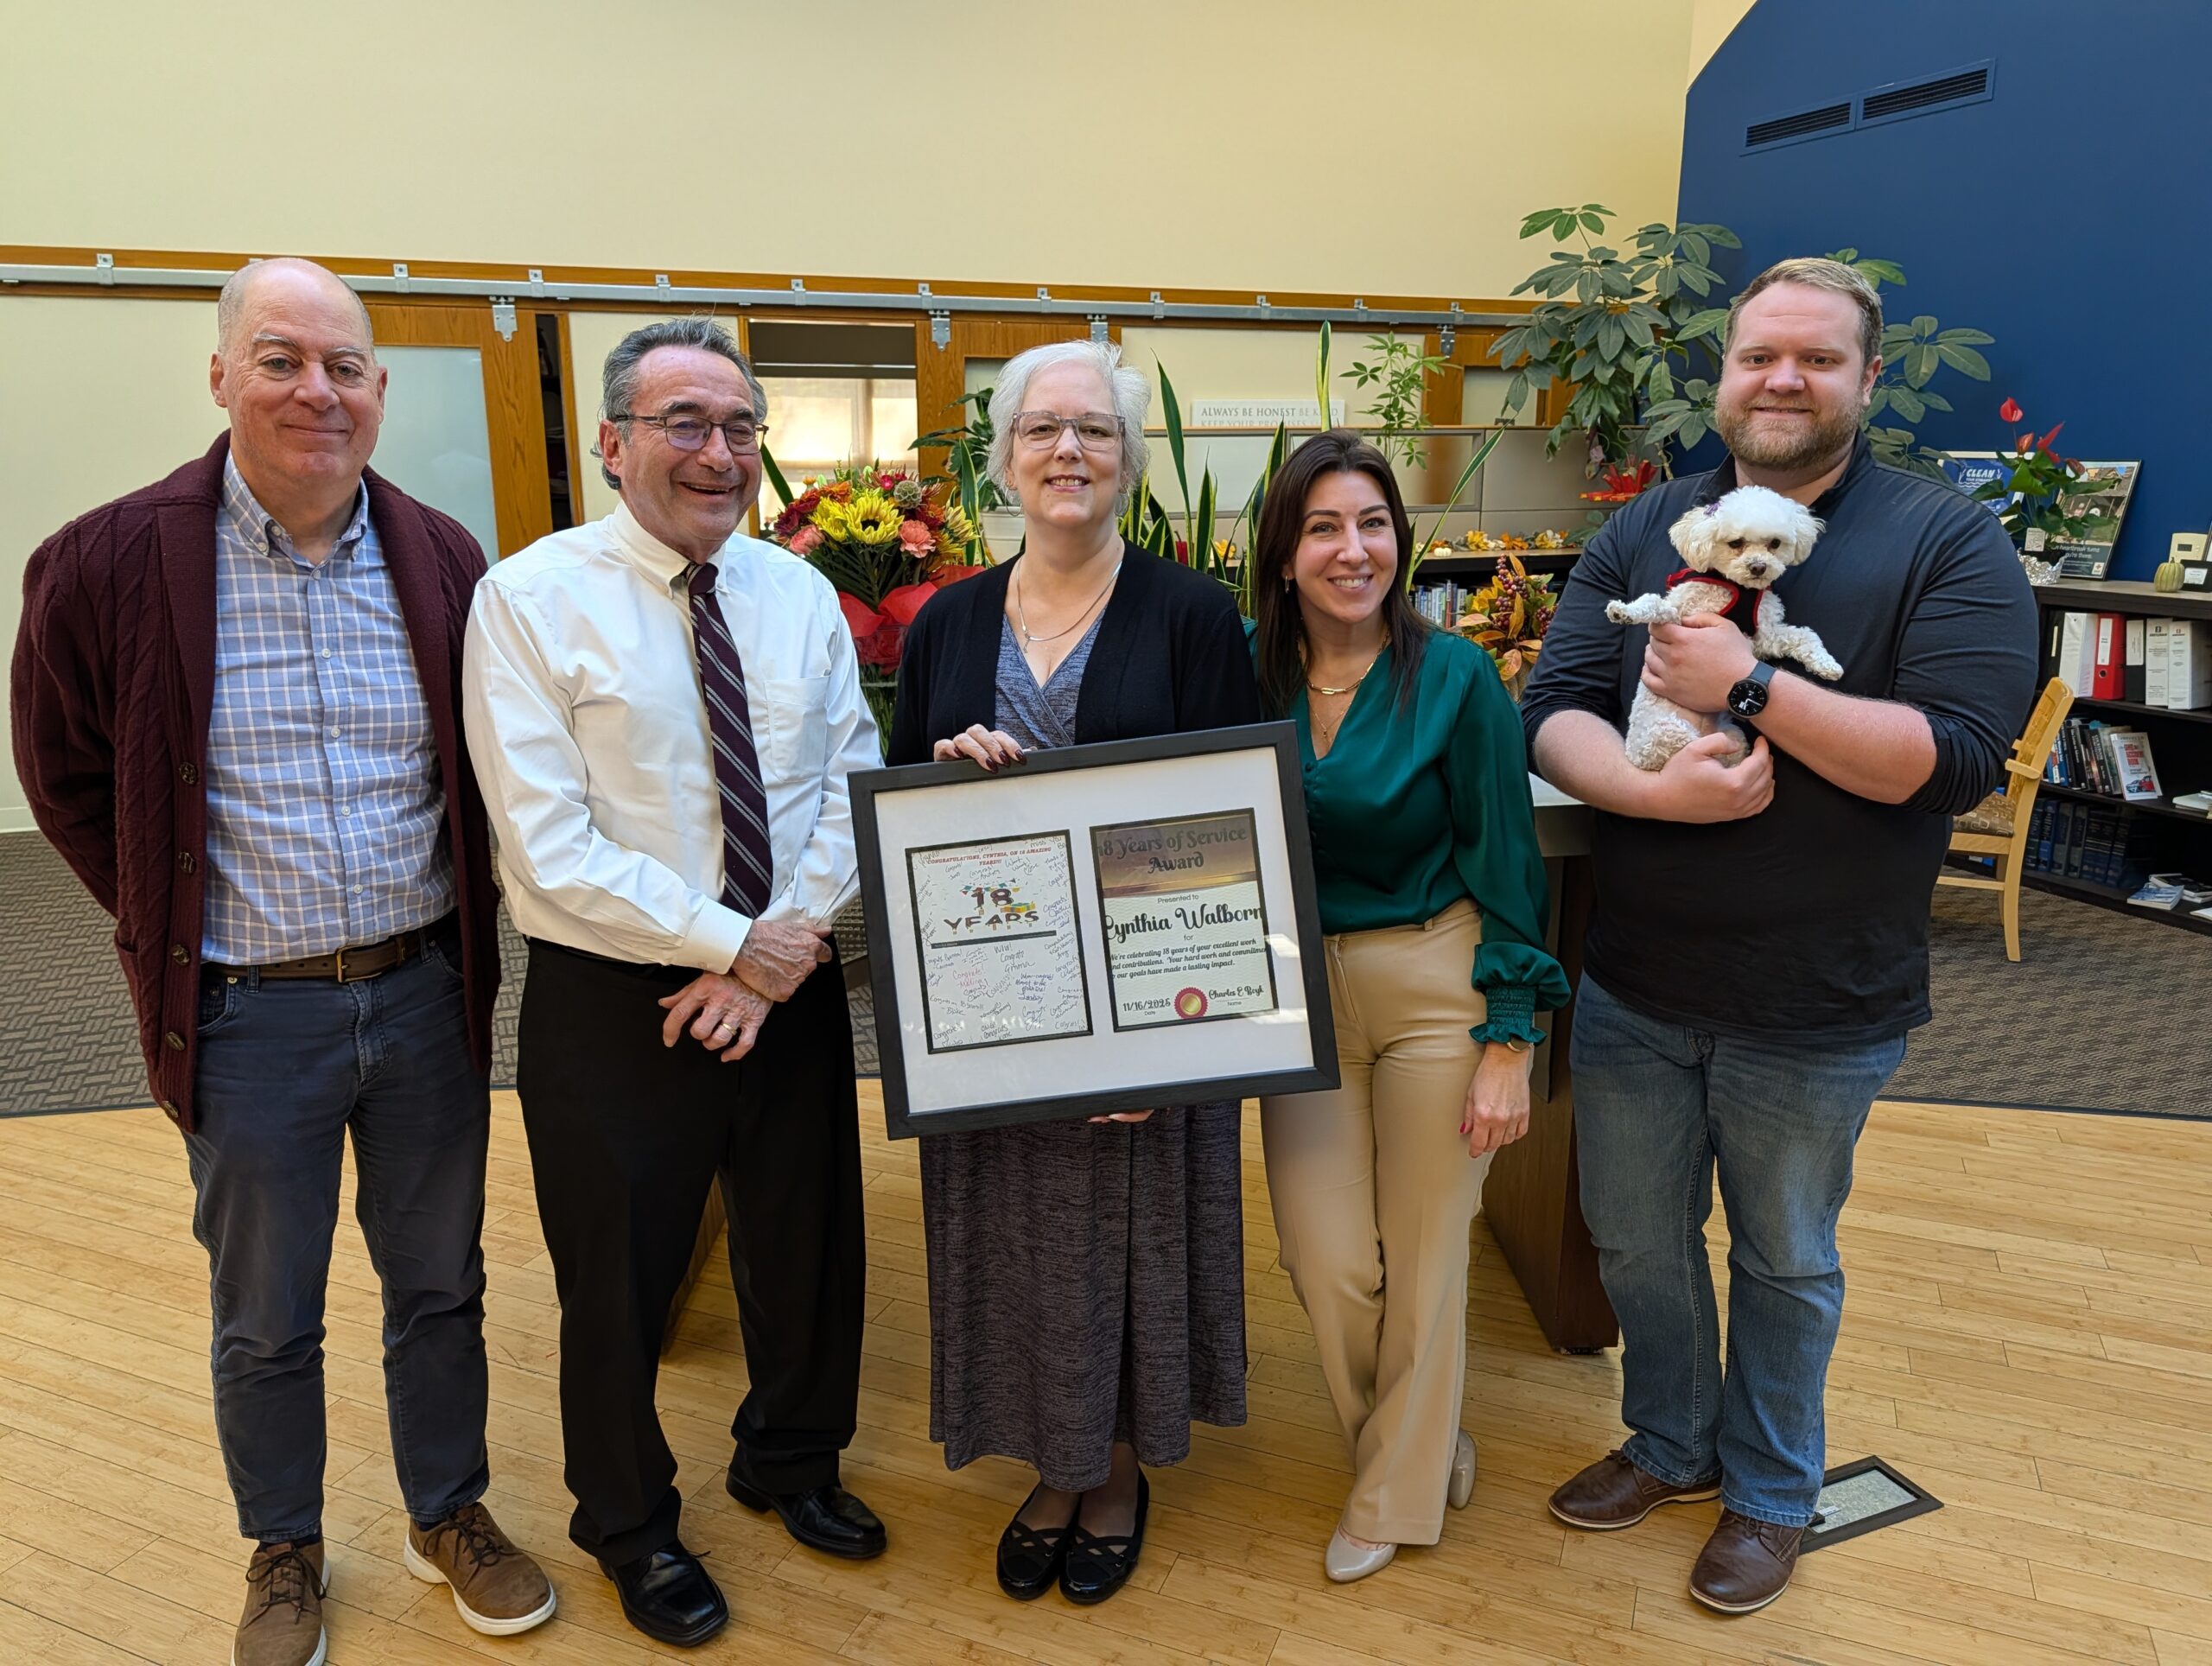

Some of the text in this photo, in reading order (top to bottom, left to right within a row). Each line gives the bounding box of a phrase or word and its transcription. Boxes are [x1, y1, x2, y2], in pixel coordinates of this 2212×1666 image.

[1201, 408, 1338, 416] ALWAYS BE HONEST BE KD
[1117, 837, 1161, 859] Years
[1166, 831, 1184, 852] of
[1187, 828, 1246, 849] Service
[927, 855, 982, 864] CONGRATULATIONS,
[1147, 852, 1205, 874] Award
[970, 886, 1014, 910] 18
[1158, 895, 1191, 904] Presented
[1106, 912, 1173, 944] Cynthia
[1127, 950, 1161, 960] celebrating
[1171, 946, 1189, 956] years
[1189, 944, 1196, 952] of
[1197, 944, 1211, 952] your
[1213, 940, 1239, 949] excellent
[1122, 957, 1165, 970] contributions.
[1166, 956, 1184, 964] Your
[1128, 970, 1147, 979] goals
[1147, 967, 1163, 976] have
[1187, 962, 1210, 972] lasting
[1211, 959, 1236, 969] impact.
[1208, 989, 1236, 1001] Charles
[1237, 987, 1244, 996] E
